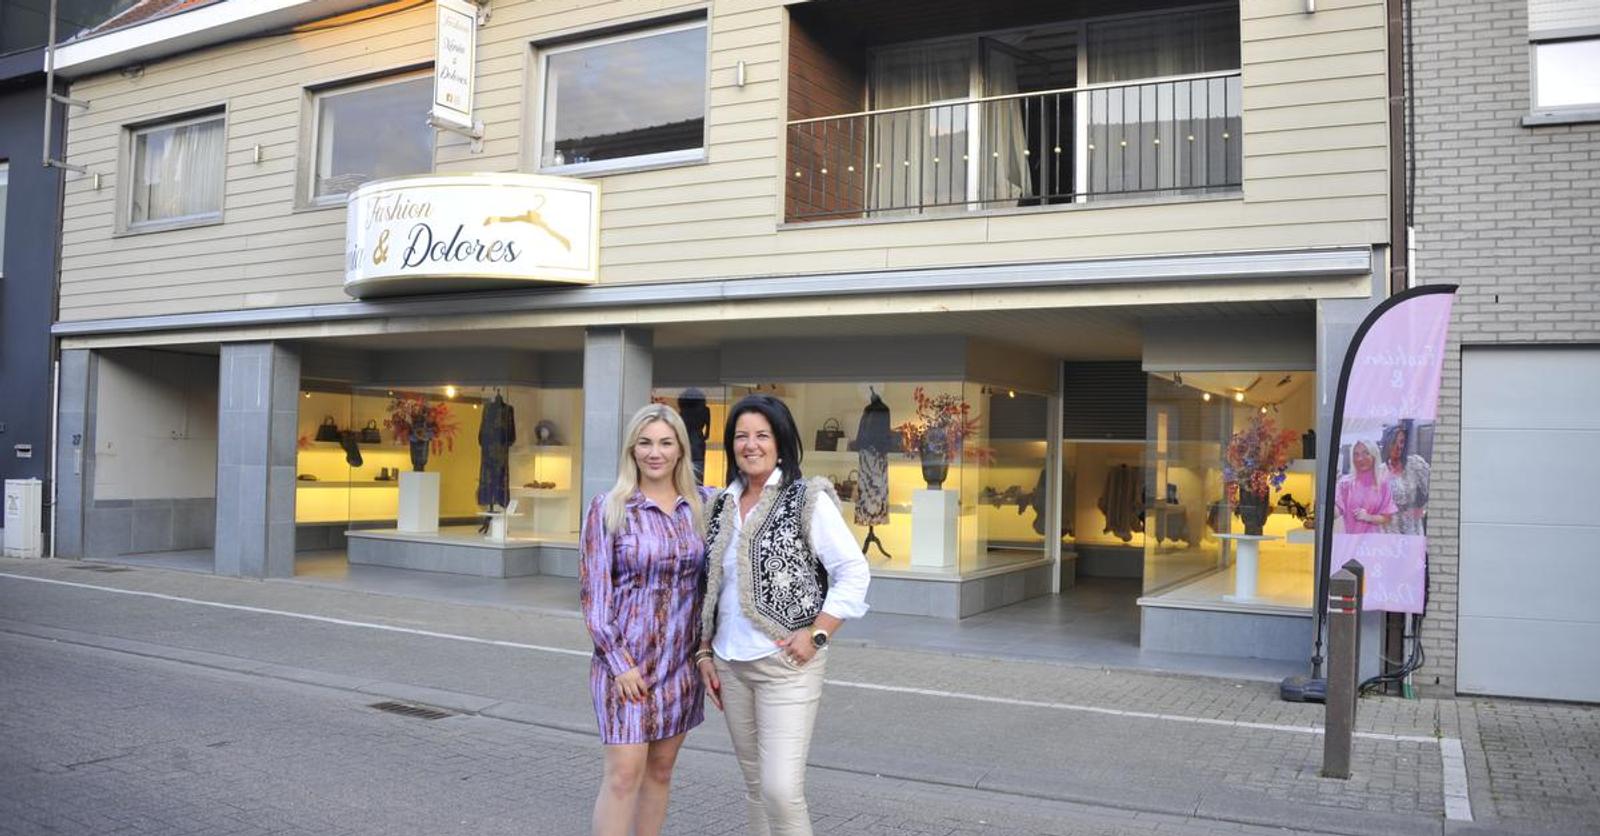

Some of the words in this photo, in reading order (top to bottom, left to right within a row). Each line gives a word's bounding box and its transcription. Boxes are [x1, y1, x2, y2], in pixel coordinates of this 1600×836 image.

[366, 193, 433, 229] Fashion
[373, 229, 390, 265] &
[401, 223, 522, 269] Dolores
